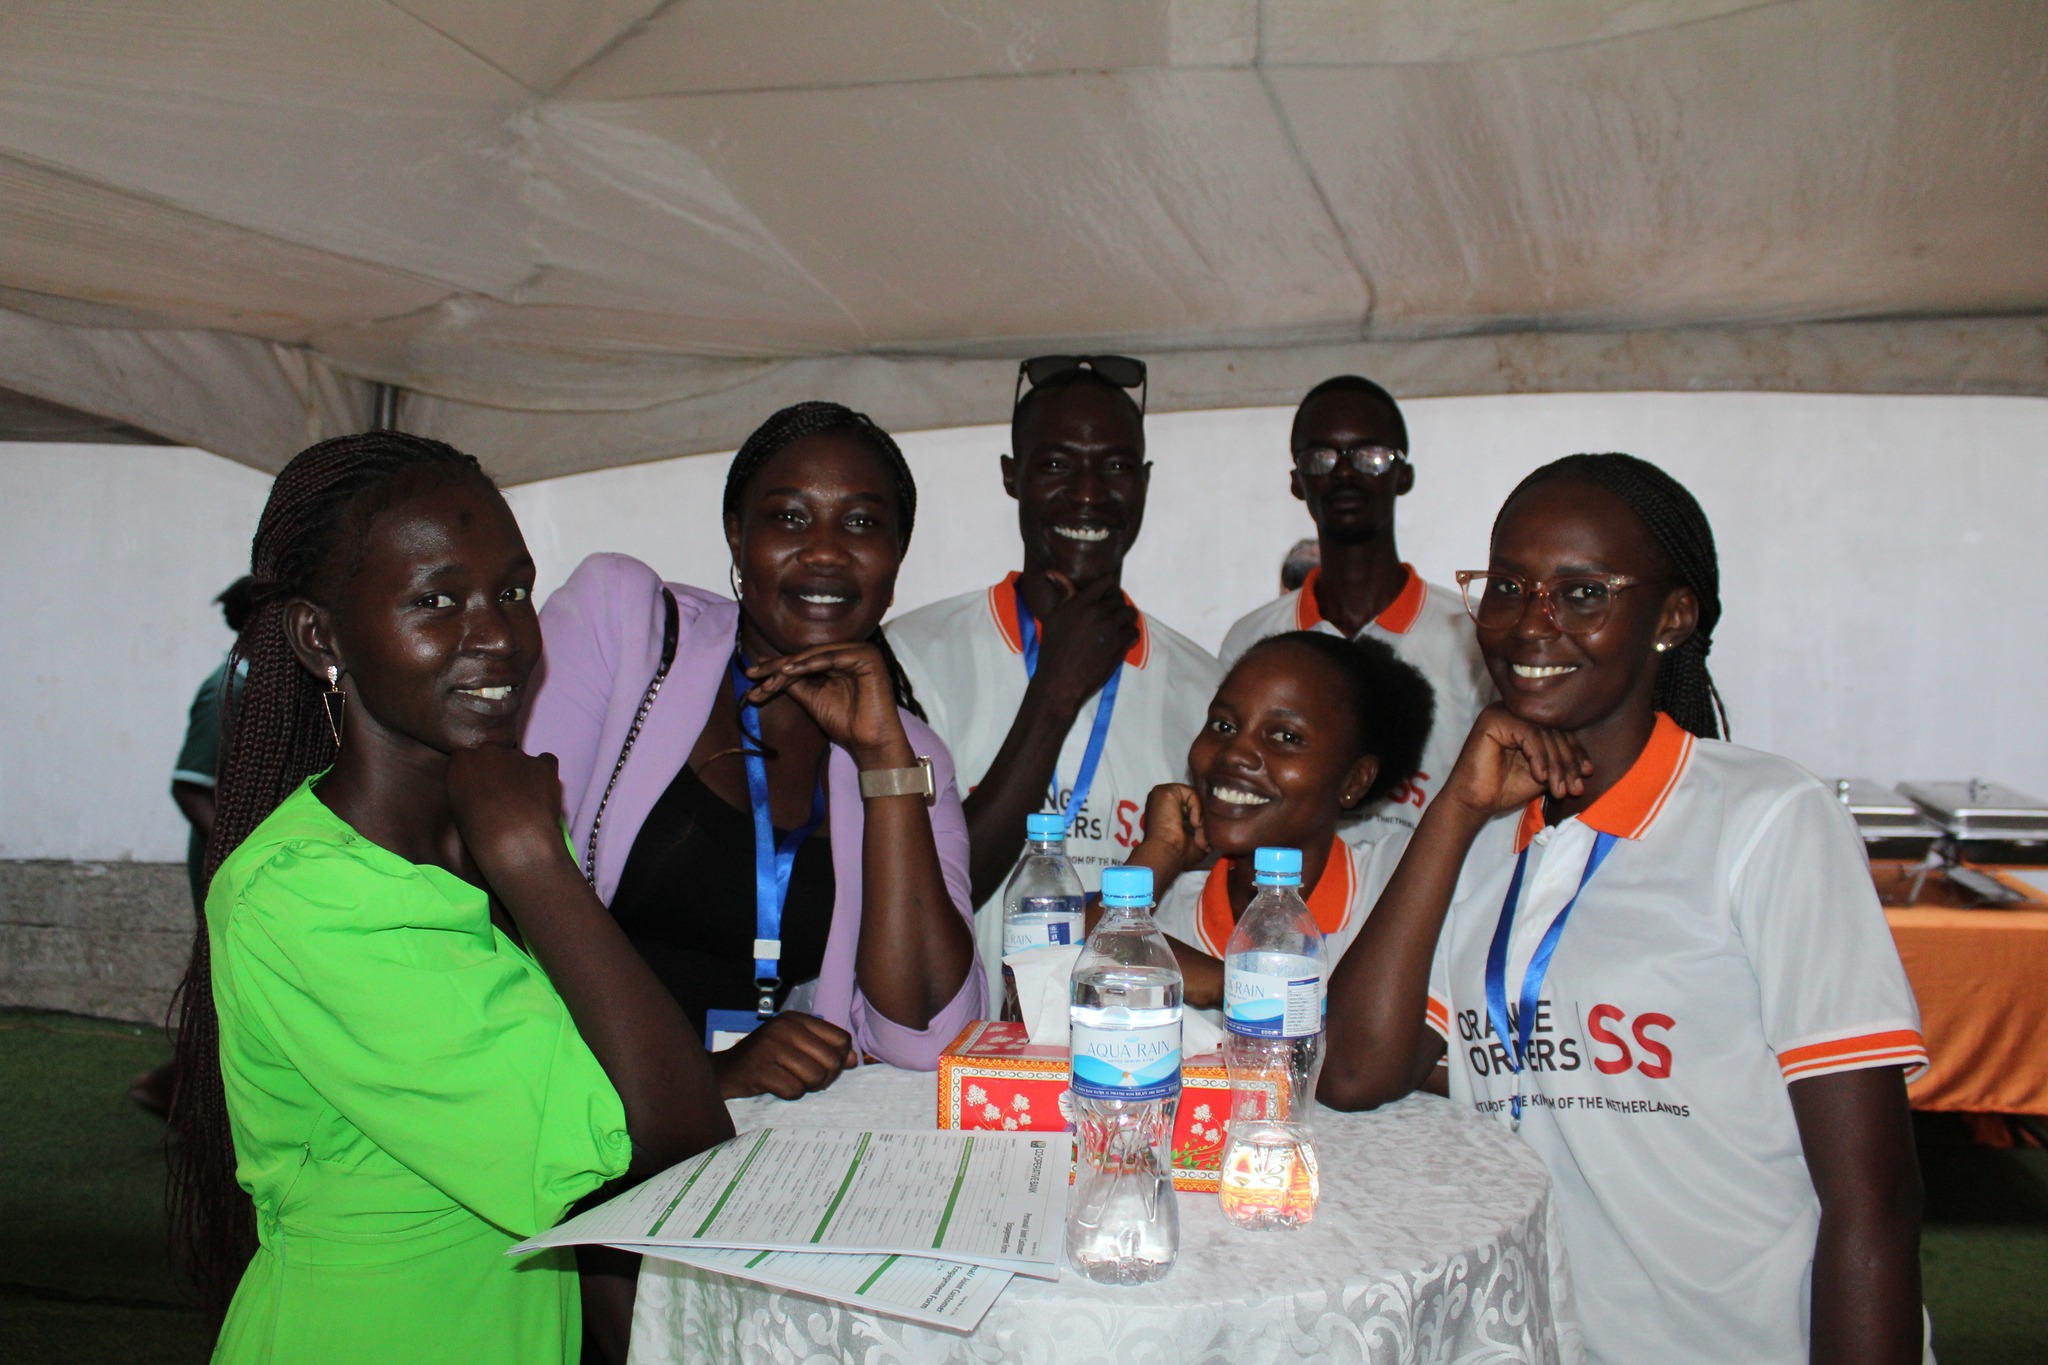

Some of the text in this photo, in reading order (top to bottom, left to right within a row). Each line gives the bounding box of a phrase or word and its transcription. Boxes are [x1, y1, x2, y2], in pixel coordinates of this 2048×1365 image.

[1235, 981, 1265, 998] RAIN
[1087, 1040, 1170, 1058] AQUA RAIN
[1588, 1004, 1676, 1079] SS
[1558, 1097, 1574, 1109] OF
[1578, 1096, 1604, 1109] THE
[1605, 1098, 1690, 1117] NETHERLANDS
[920, 1294, 937, 1310] Form
